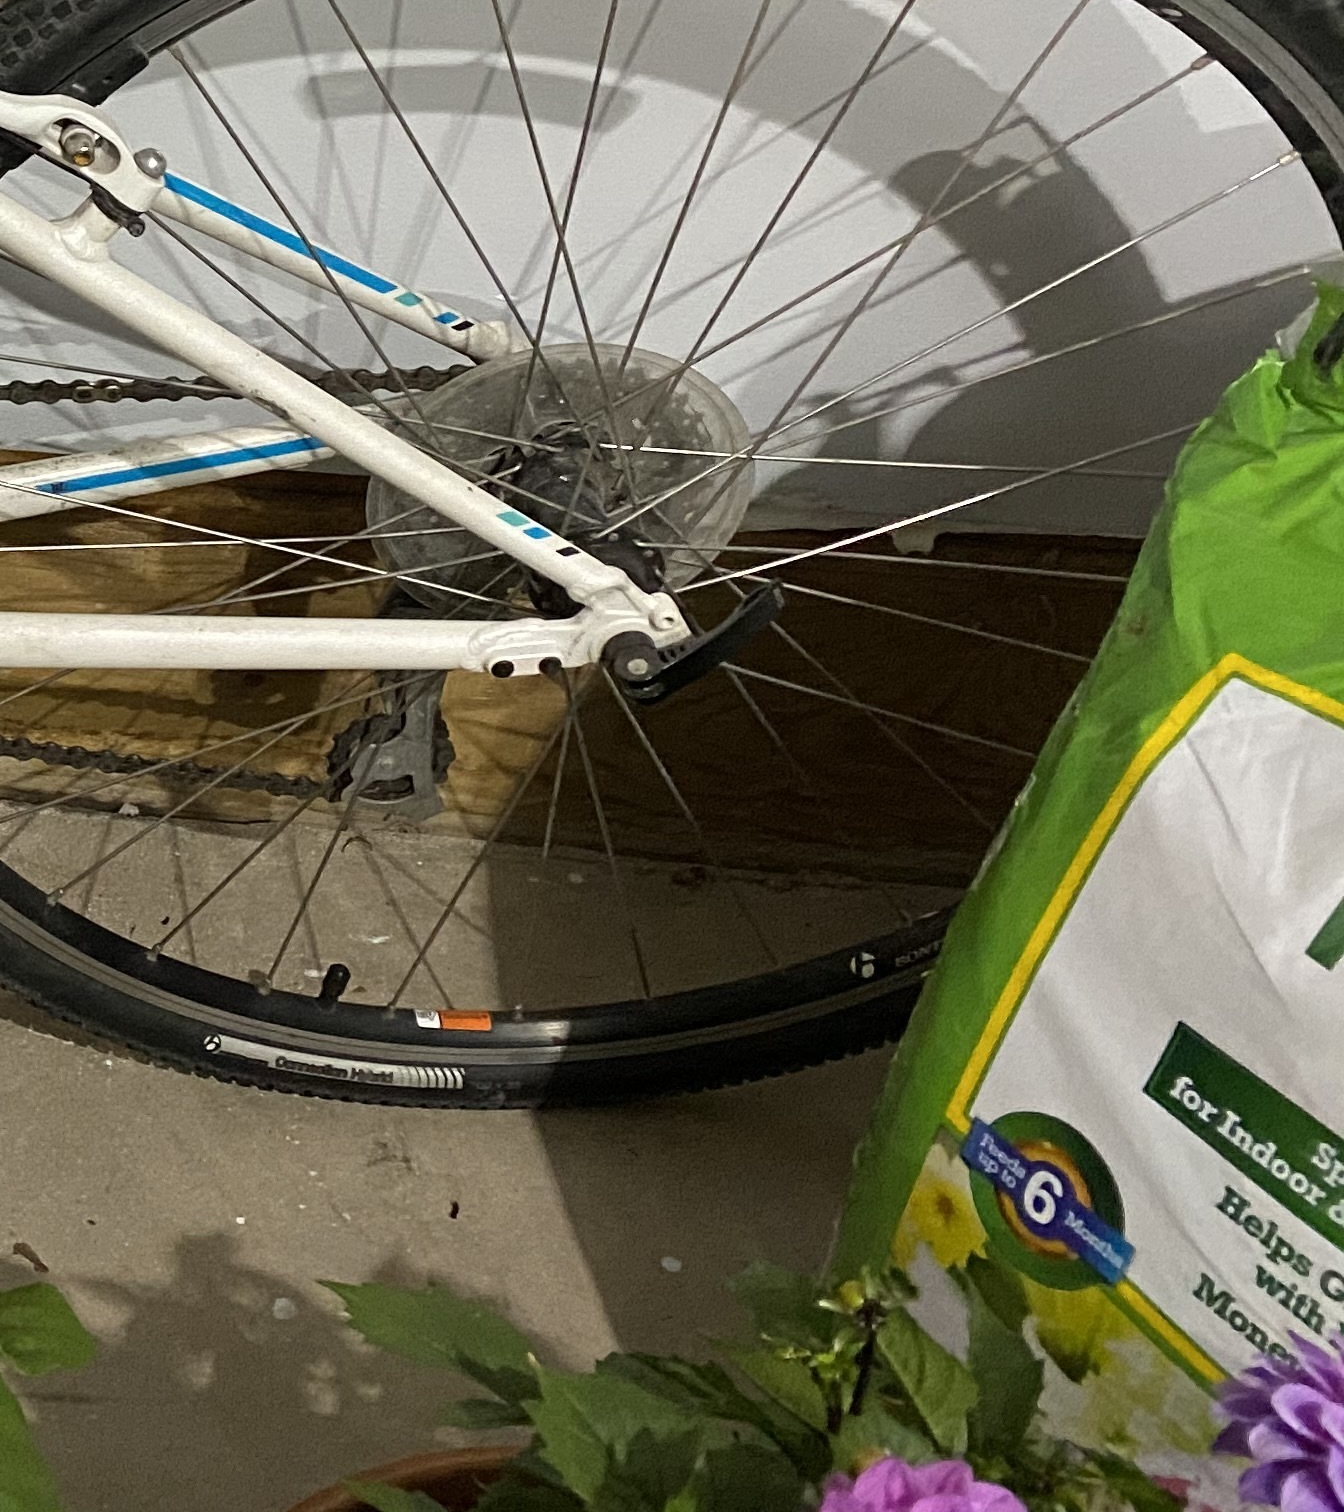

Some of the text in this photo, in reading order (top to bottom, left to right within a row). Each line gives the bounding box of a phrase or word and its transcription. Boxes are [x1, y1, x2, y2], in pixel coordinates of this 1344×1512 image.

[978, 1152, 1017, 1189] up to
[979, 1132, 1027, 1179] Feeds
[1168, 1075, 1219, 1123] for
[1216, 1110, 1327, 1207] Indoor
[1023, 1170, 1064, 1225] 6
[1215, 1185, 1314, 1278] Helps
[1255, 1263, 1325, 1336] with
